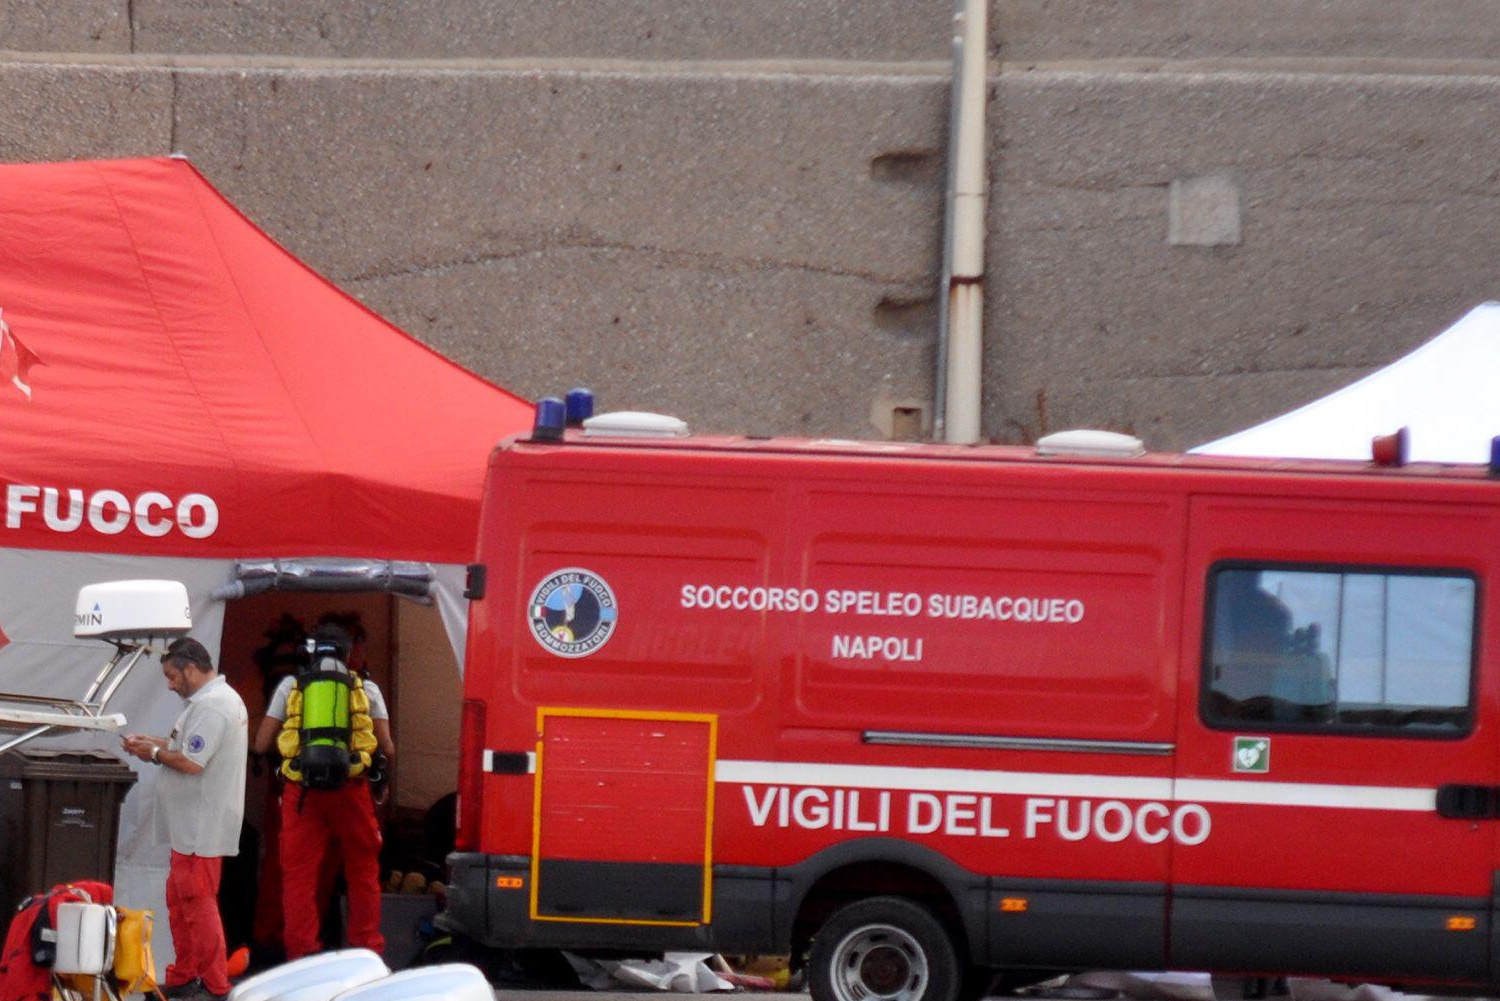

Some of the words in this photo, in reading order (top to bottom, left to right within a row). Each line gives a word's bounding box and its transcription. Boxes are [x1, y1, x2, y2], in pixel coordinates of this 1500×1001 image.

[5, 485, 219, 538] FUOCO
[681, 584, 818, 613] SOCCORSO
[825, 590, 922, 616] SPELEO
[928, 594, 1084, 623] SUBACQUEO
[832, 635, 923, 661] NAPOLI
[742, 785, 891, 832] VIGILI
[907, 793, 1010, 838] DEL
[1024, 798, 1212, 846] FUOCO
